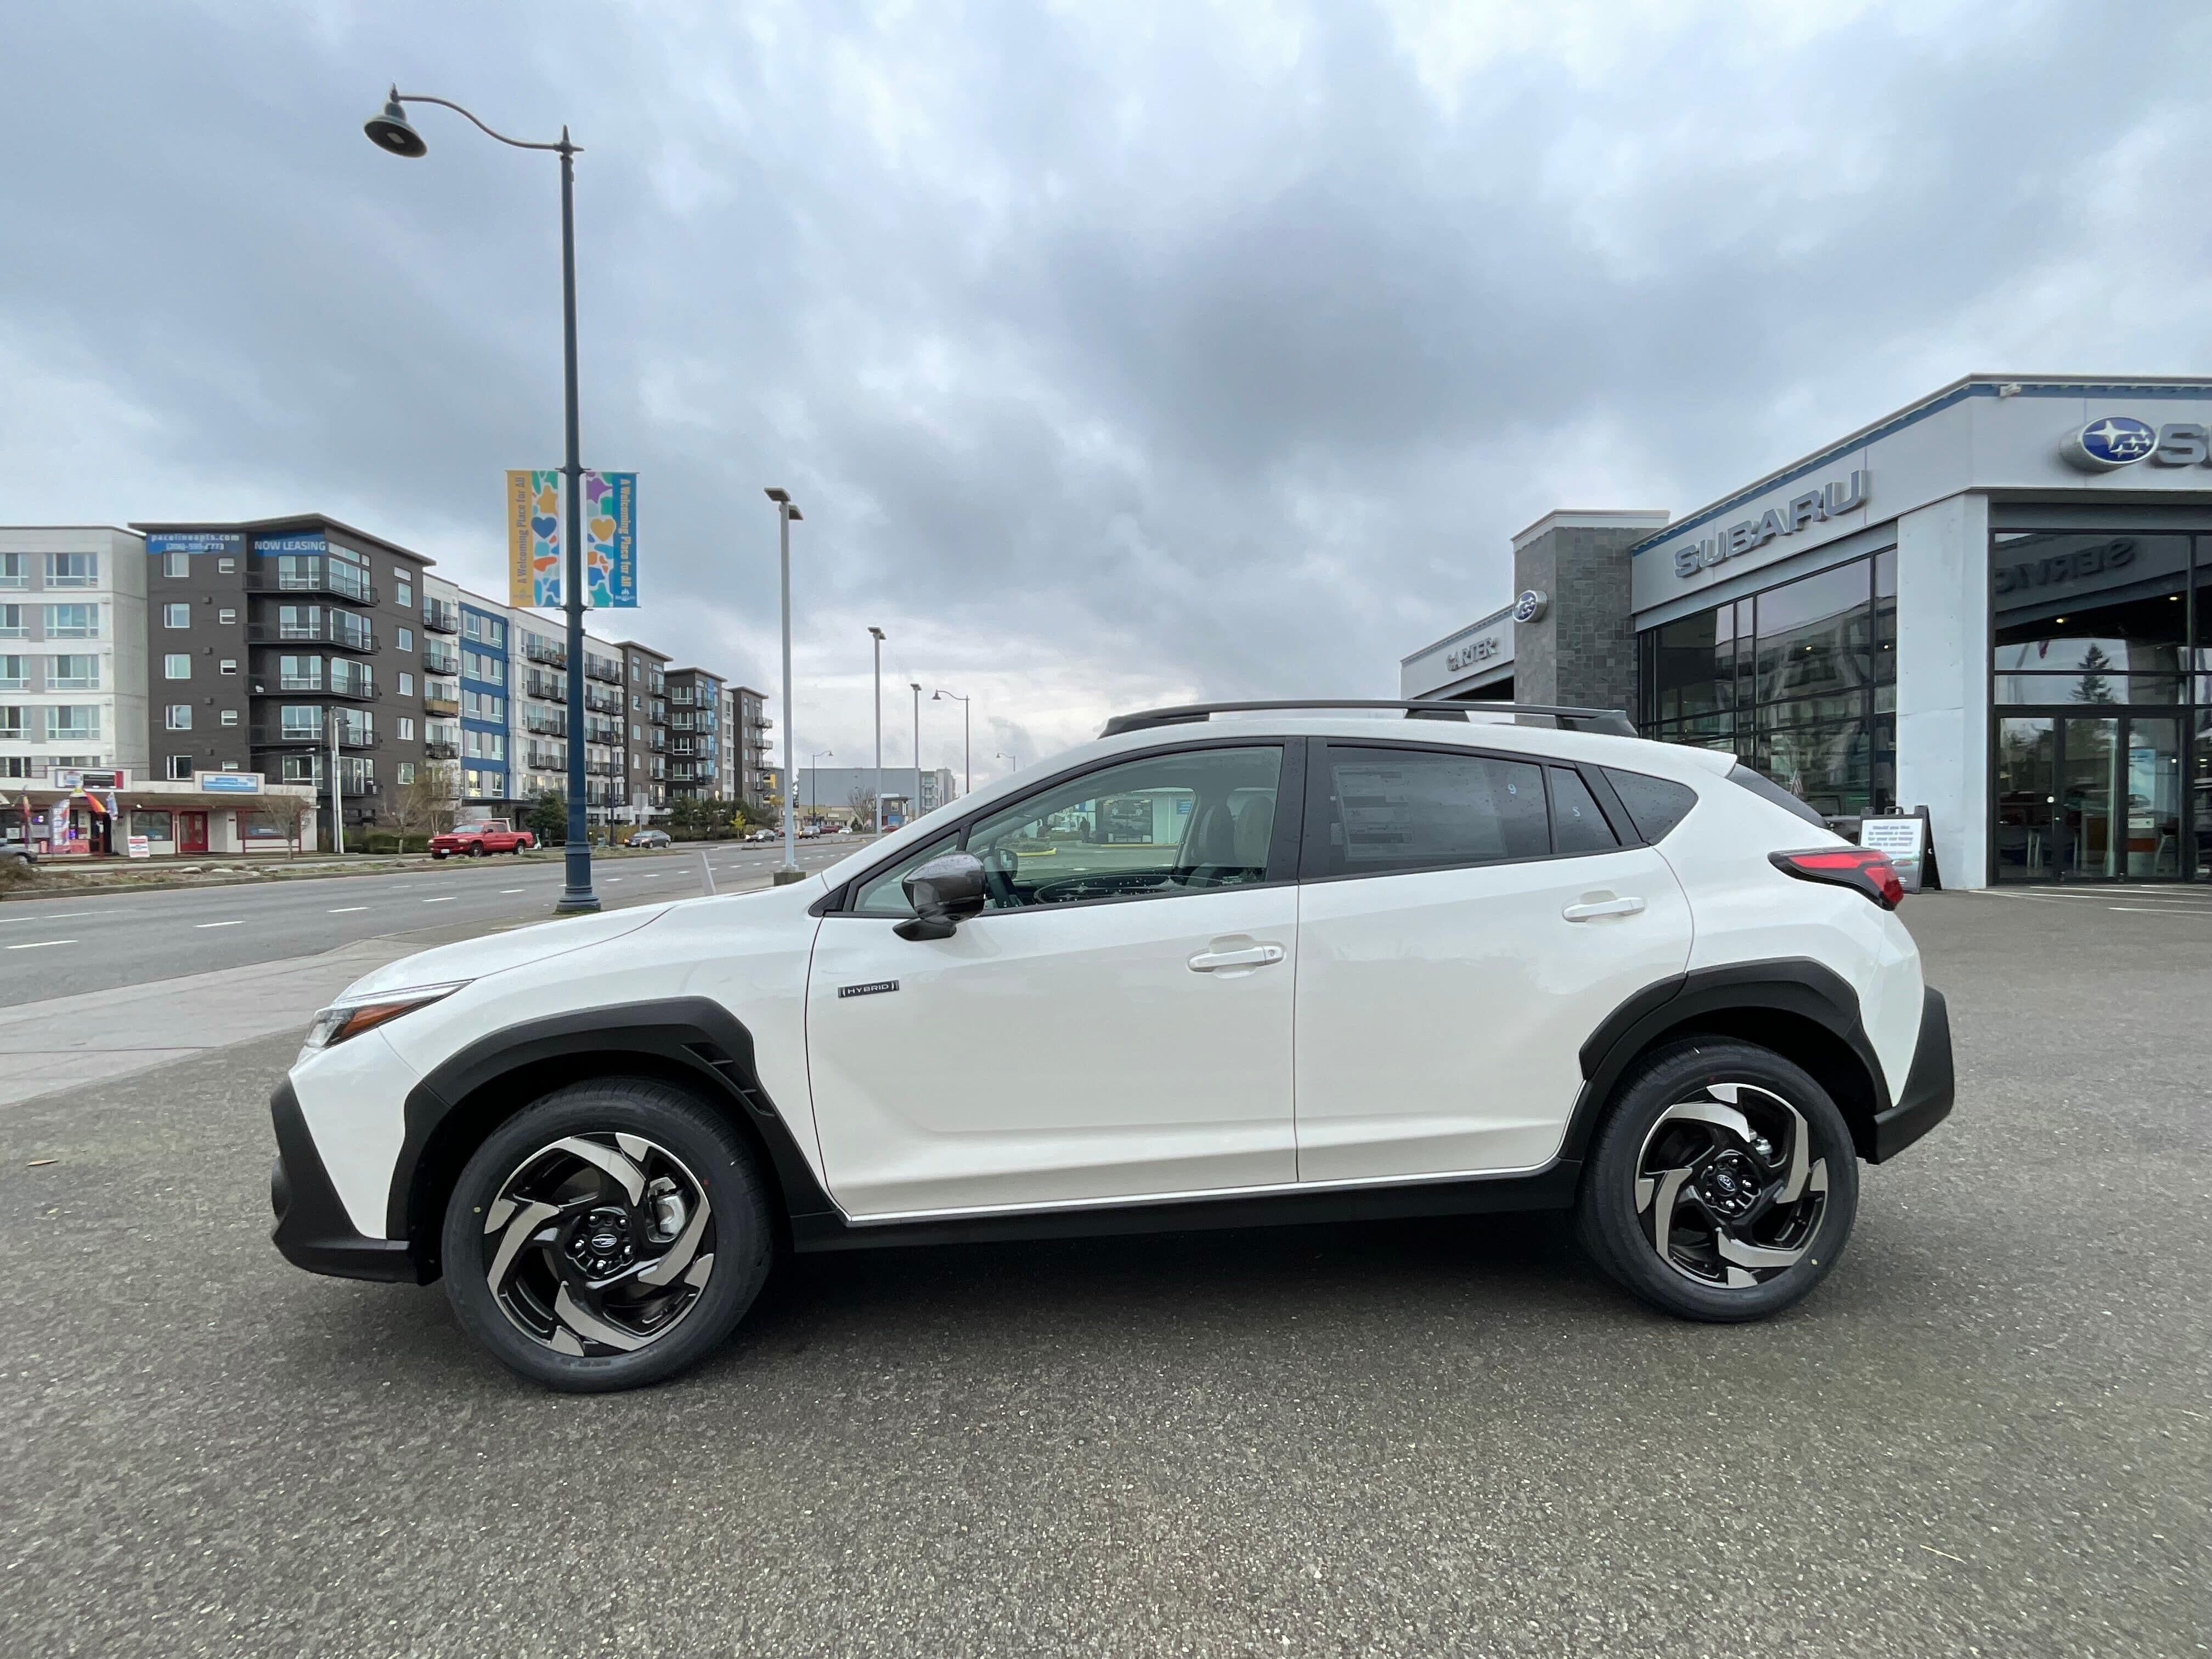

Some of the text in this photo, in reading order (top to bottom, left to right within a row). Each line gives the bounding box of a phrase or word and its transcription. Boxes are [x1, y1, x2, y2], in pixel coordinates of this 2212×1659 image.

[2159, 424, 2212, 464] S
[515, 477, 525, 488] All
[516, 490, 526, 502] for
[516, 504, 526, 528] Place
[618, 487, 630, 534] Welcoming
[1675, 470, 1867, 578] SUBARU
[255, 540, 326, 551] NOW LEASING
[517, 529, 528, 578] Welcoming
[620, 536, 631, 560] Place
[620, 561, 631, 574] for
[621, 575, 632, 587] All
[1446, 636, 1498, 671] CARTER
[848, 984, 889, 994] HYBRID
